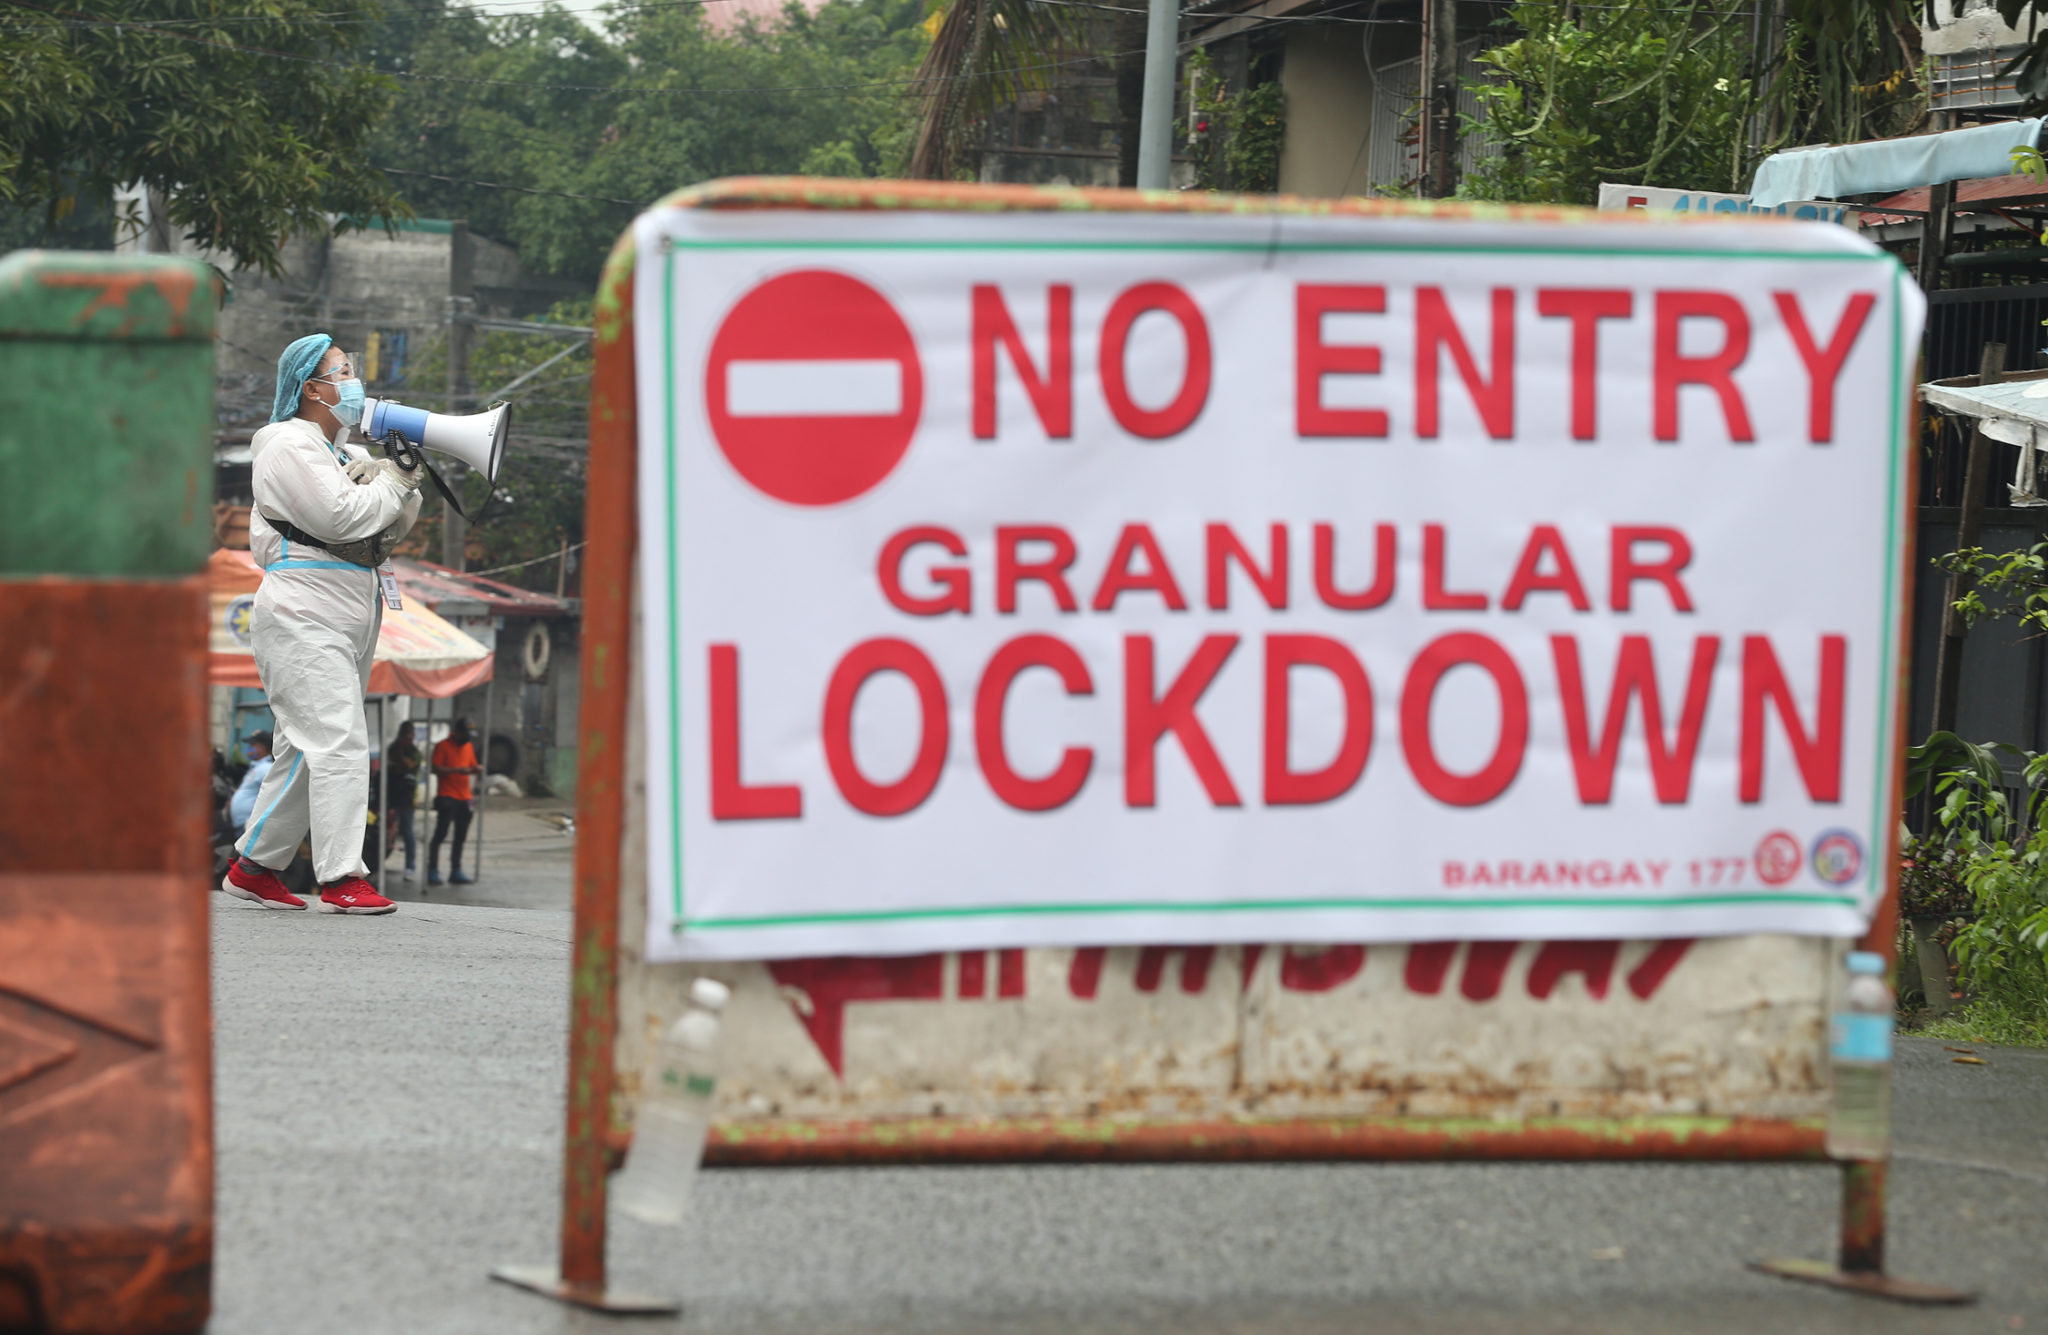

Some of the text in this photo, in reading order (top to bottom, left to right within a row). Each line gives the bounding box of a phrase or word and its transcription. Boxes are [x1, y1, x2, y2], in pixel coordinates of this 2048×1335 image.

[969, 280, 1877, 444] NO ENTRY
[876, 521, 1694, 616] GRANULAR
[707, 629, 1848, 821] LOCKDOWN
[1441, 857, 1748, 889] BARANGAY 177
